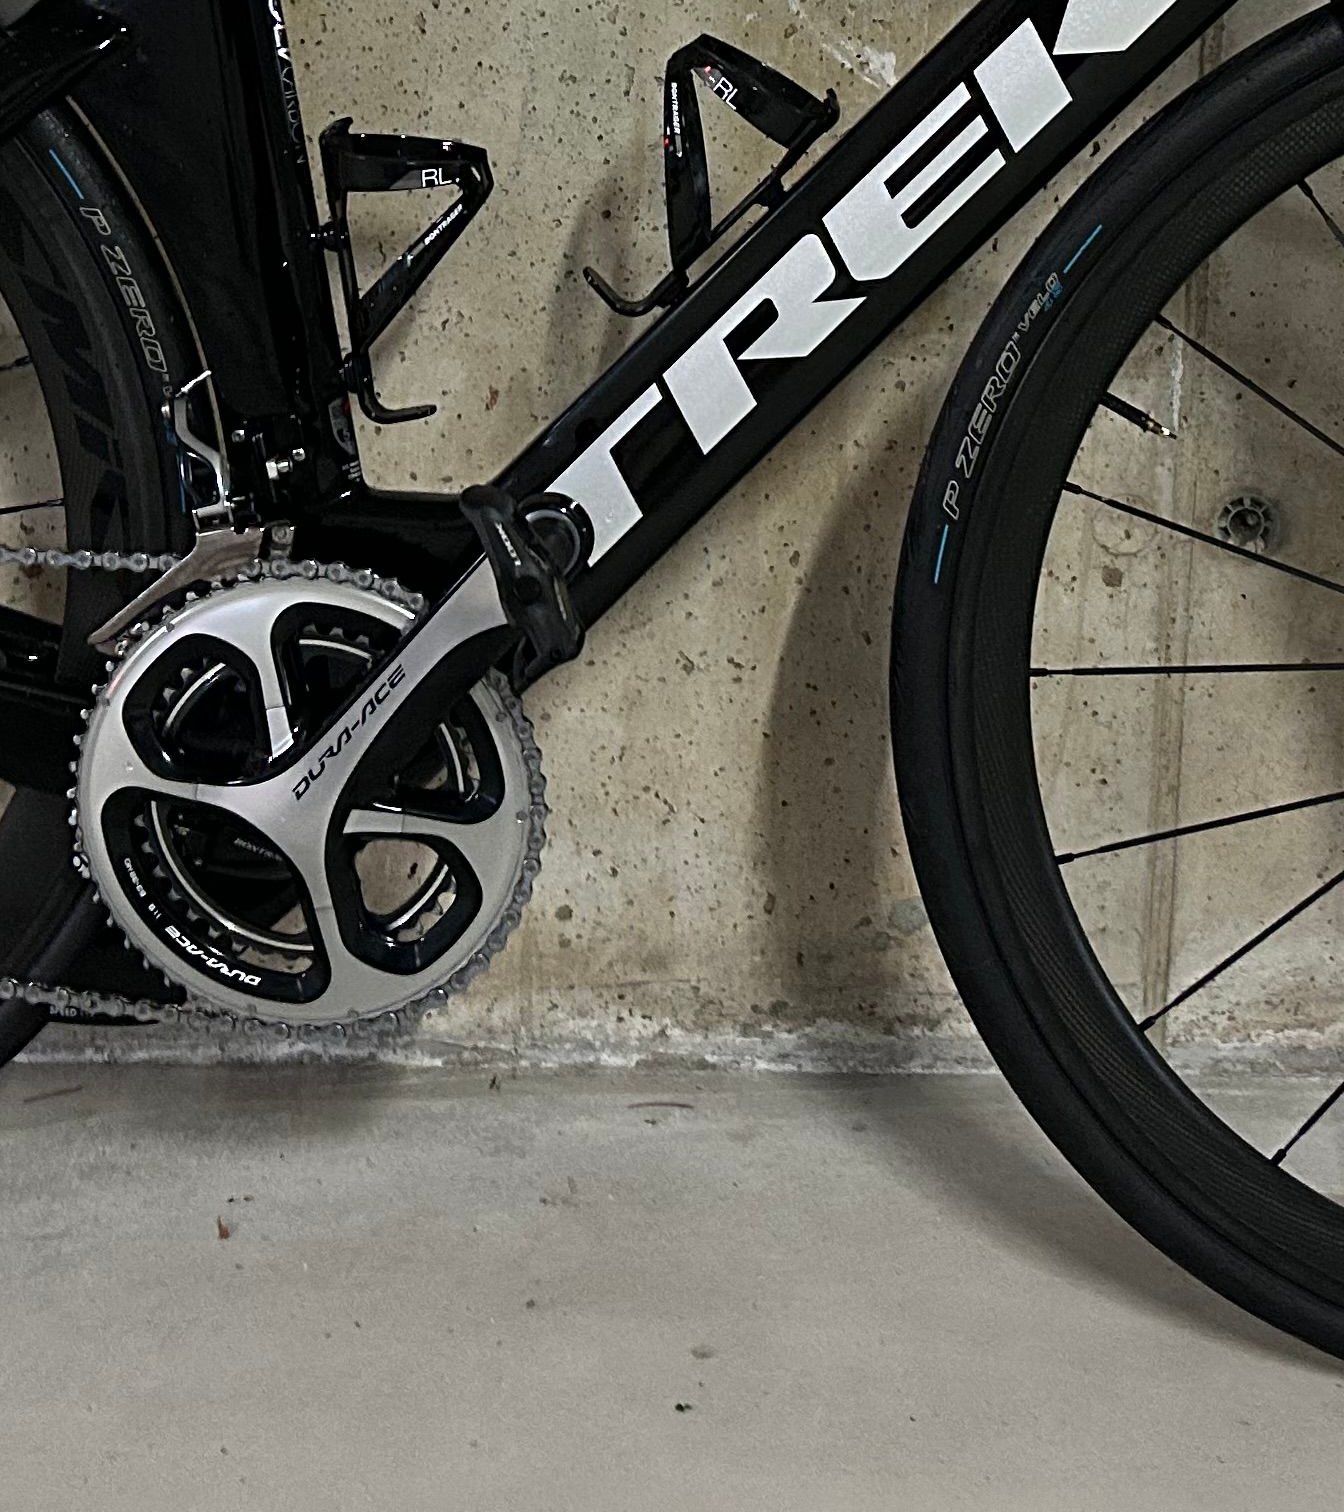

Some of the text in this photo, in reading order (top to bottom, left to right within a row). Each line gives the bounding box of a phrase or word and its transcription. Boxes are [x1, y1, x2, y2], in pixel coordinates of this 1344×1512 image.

[671, 81, 681, 135] BONTRAGER
[714, 76, 737, 110] RL
[421, 168, 453, 188] RL
[423, 203, 463, 245] BONTRAGER
[78, 205, 169, 374] P ZERO
[942, 480, 960, 520] P
[1018, 272, 1060, 333] VELO
[292, 663, 406, 801] DURA-ACE
[164, 925, 262, 986] DURA-ACE
